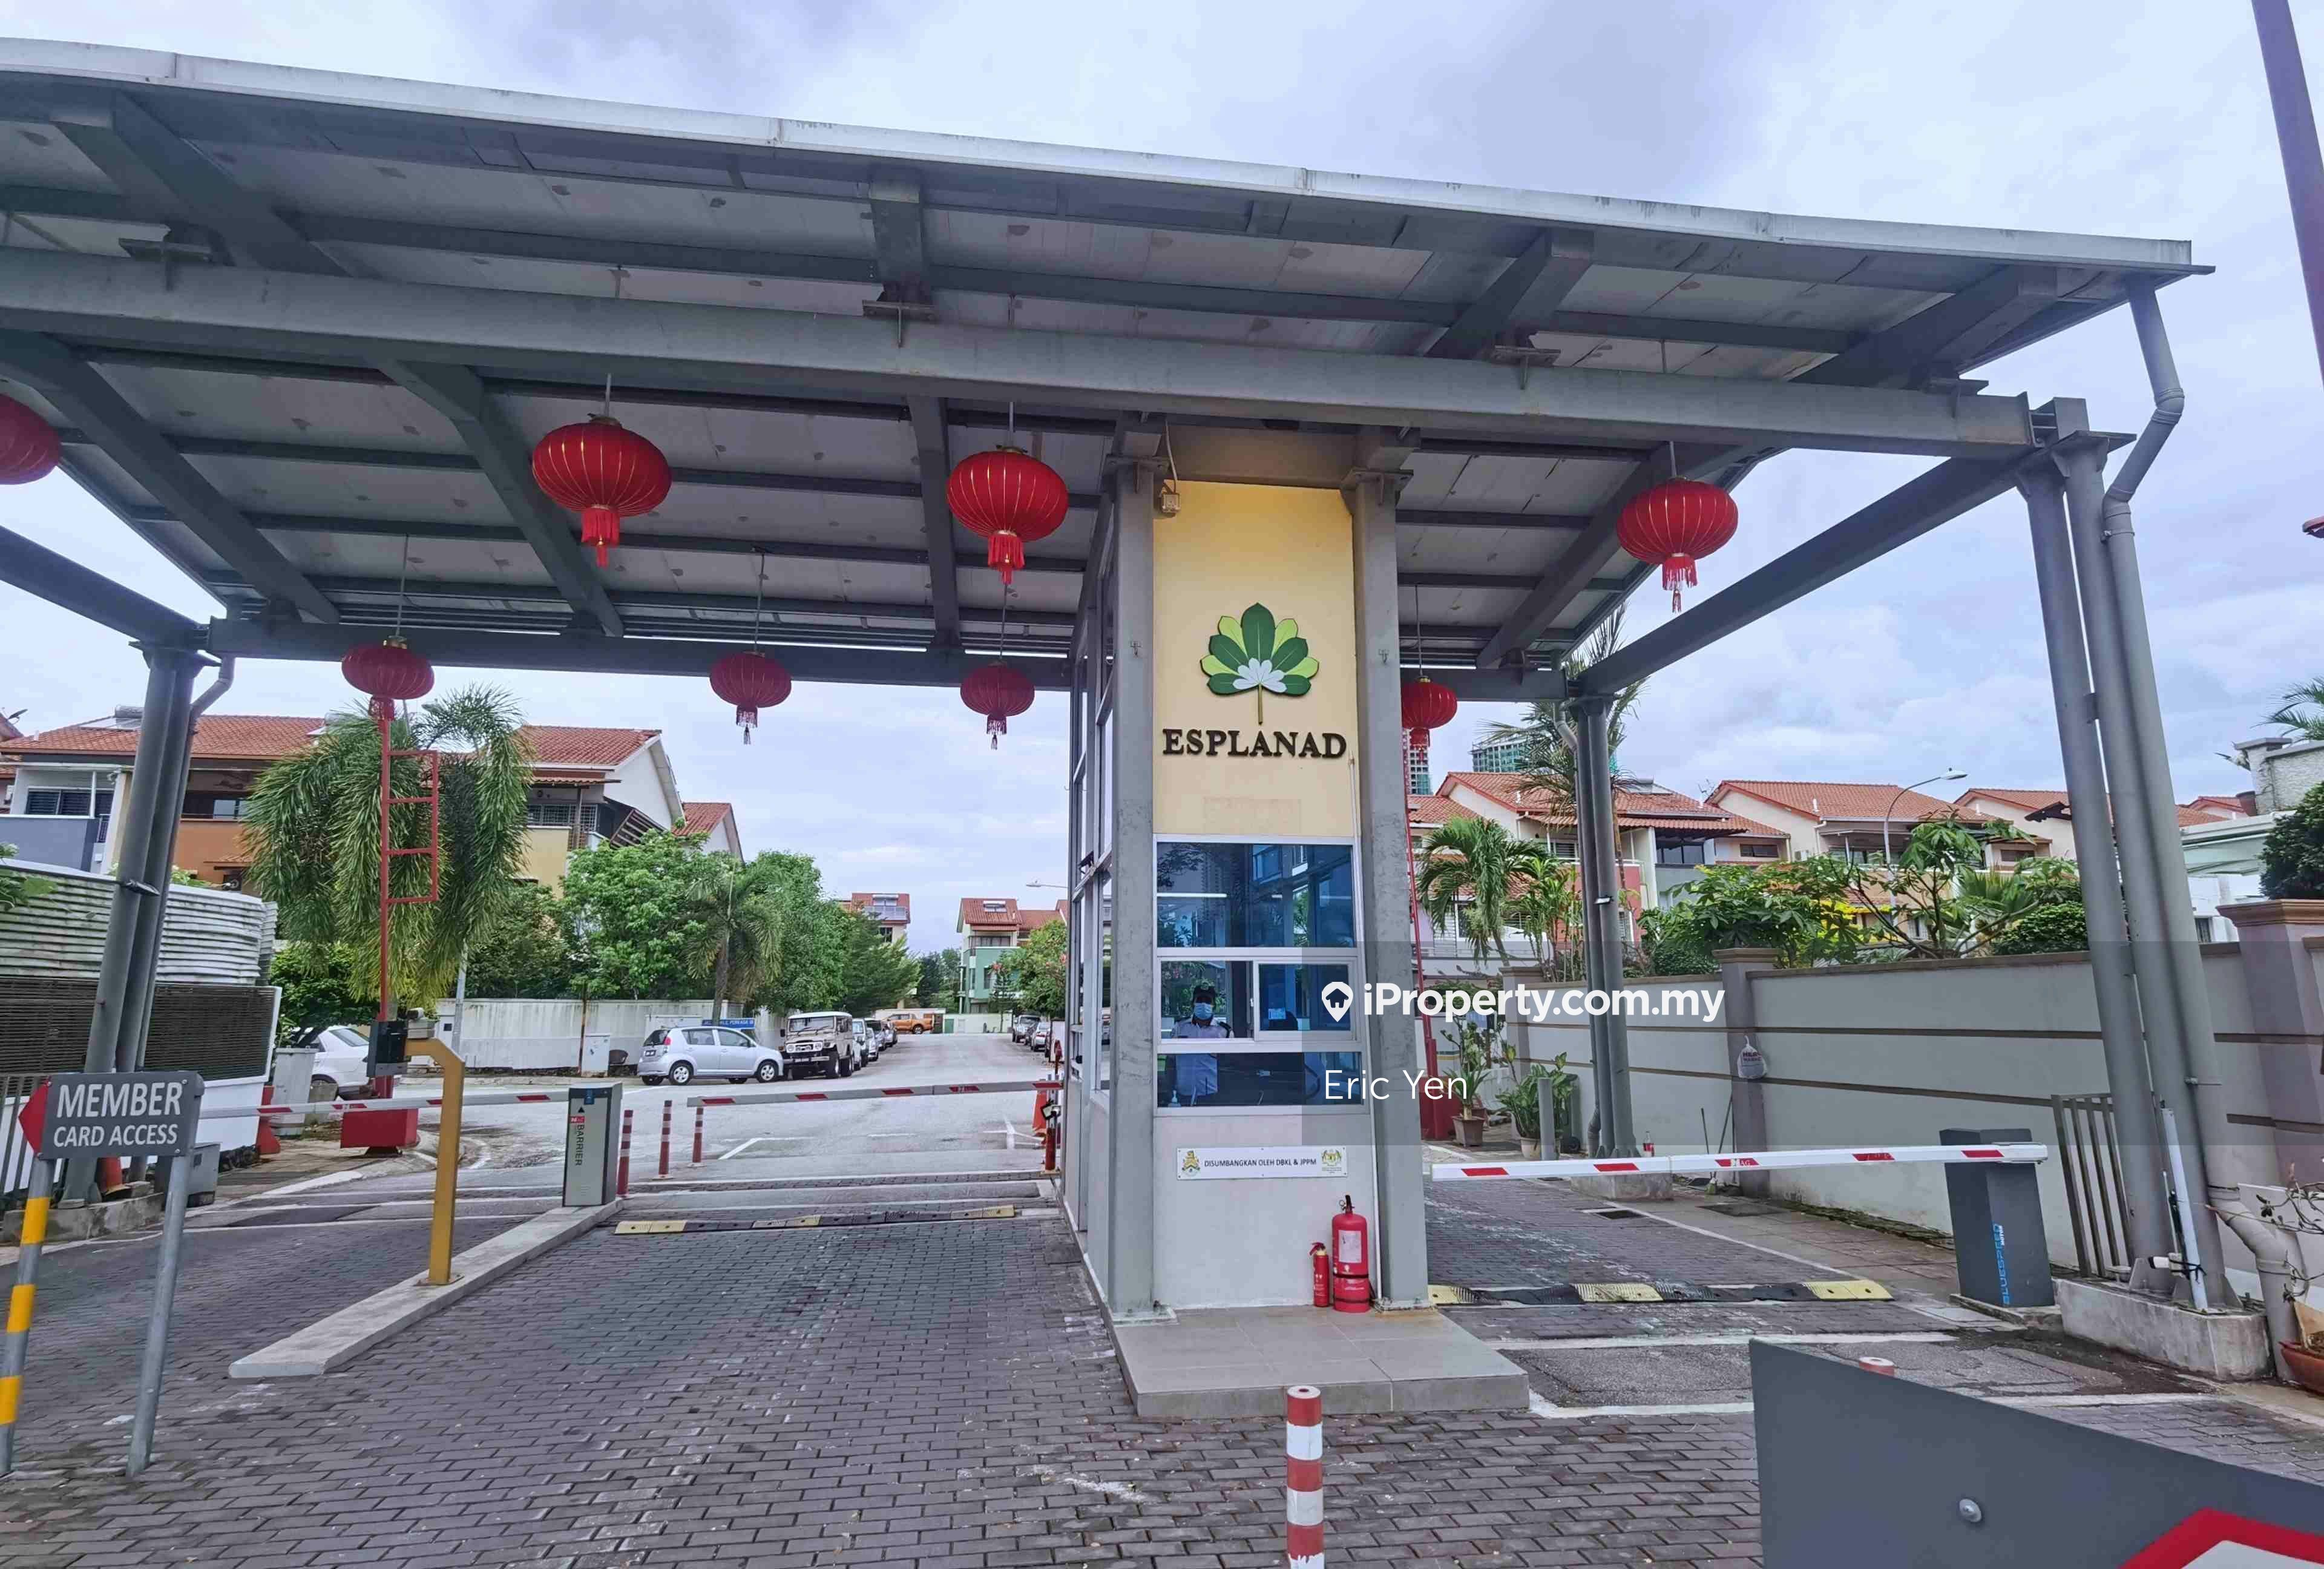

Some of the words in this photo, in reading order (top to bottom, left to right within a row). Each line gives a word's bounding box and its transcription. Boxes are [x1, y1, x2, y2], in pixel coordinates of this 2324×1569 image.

[1162, 728, 1347, 758] ESPLANAD
[57, 1082, 183, 1118] MEMBER
[53, 1125, 105, 1147] CARD
[108, 1123, 179, 1146] ACCESS
[575, 1124, 585, 1166] BARRIER
[1992, 1223, 2010, 1304] BLUESPEED
